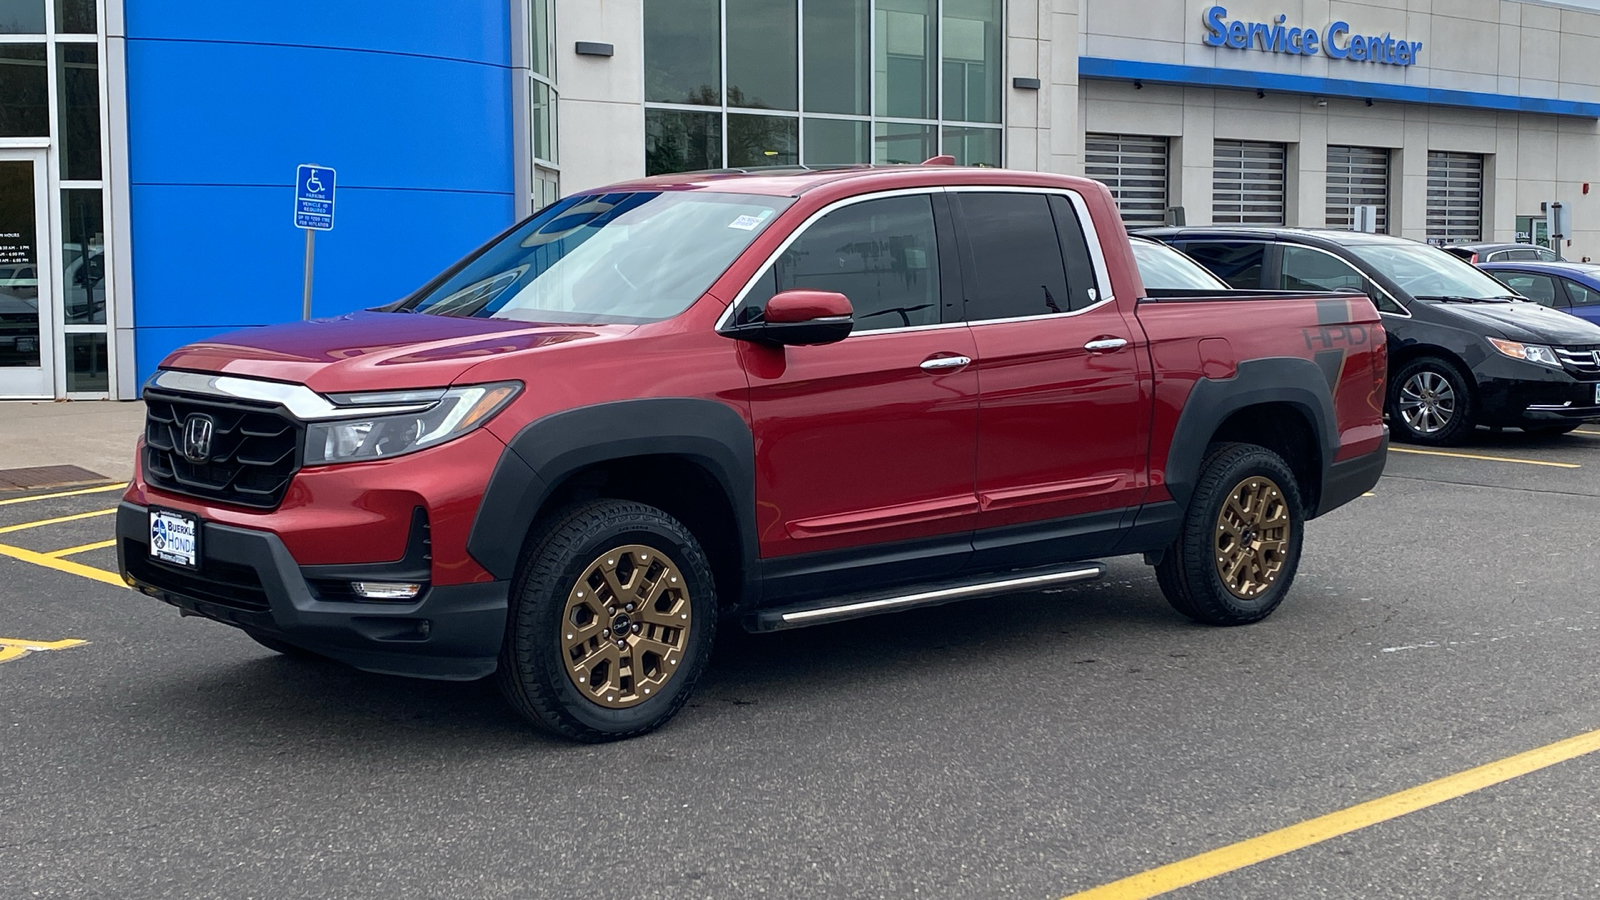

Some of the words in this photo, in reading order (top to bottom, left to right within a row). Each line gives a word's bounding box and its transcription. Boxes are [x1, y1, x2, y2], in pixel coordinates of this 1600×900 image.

[1202, 5, 1319, 56] Service
[1322, 20, 1423, 66] Center
[1302, 324, 1368, 350] HPD
